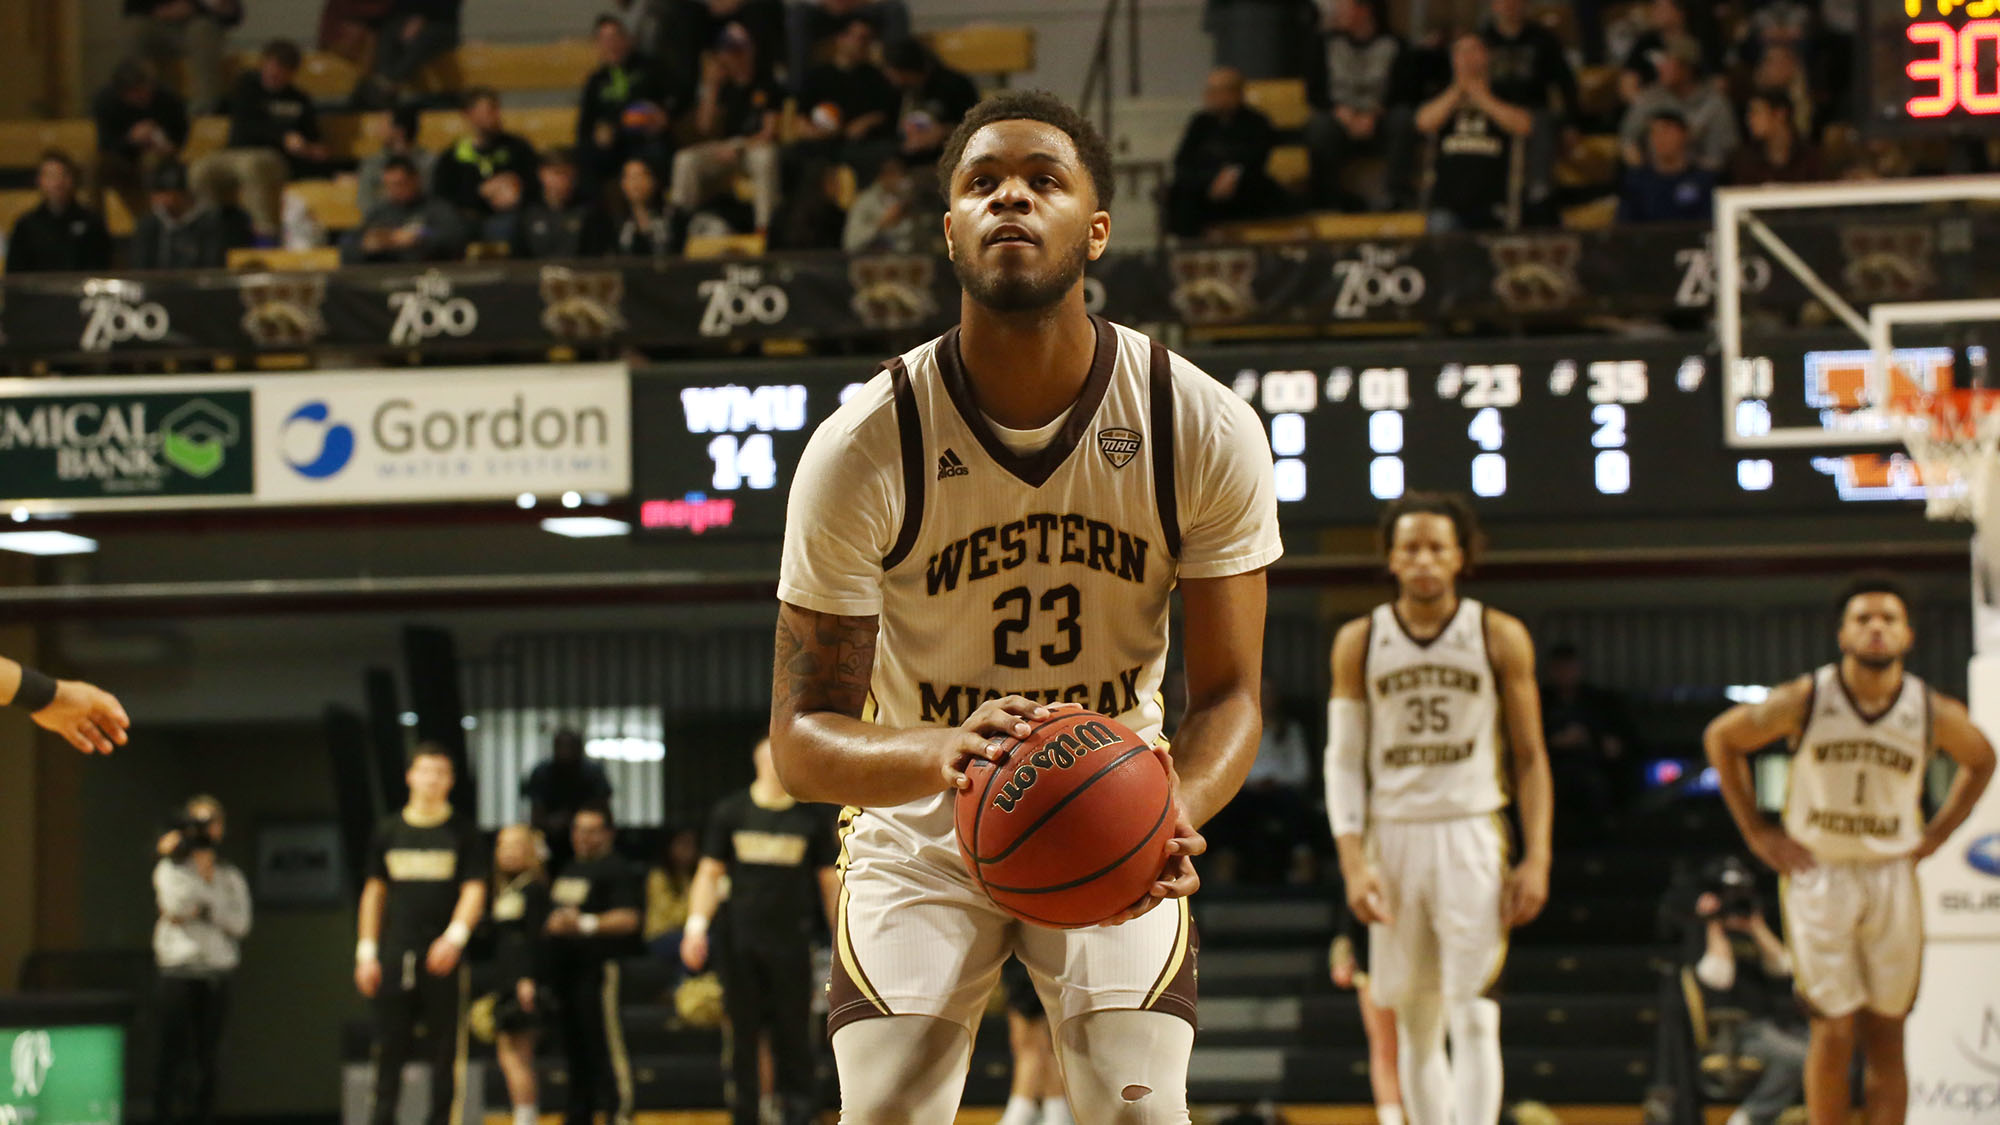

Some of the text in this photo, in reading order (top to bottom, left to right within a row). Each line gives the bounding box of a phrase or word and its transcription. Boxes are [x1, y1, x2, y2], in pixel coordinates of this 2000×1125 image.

[1905, 20, 2000, 118] 30
[371, 391, 608, 456] Gordon
[680, 384, 808, 434] WMU
[1467, 407, 1504, 451] 4
[1590, 403, 1627, 448] 2
[56, 446, 167, 481] BANK
[707, 433, 777, 491] 14
[1101, 440, 1139, 452] MAC
[925, 512, 1149, 597] WESTERN
[992, 583, 1082, 669] 23
[1376, 663, 1481, 699] WESTERN
[1406, 695, 1450, 734] 35
[992, 720, 1125, 814] Wilson
[1383, 737, 1475, 770] MICHIGAN
[1814, 738, 1915, 776] WESTERN
[1855, 770, 1867, 805] 1
